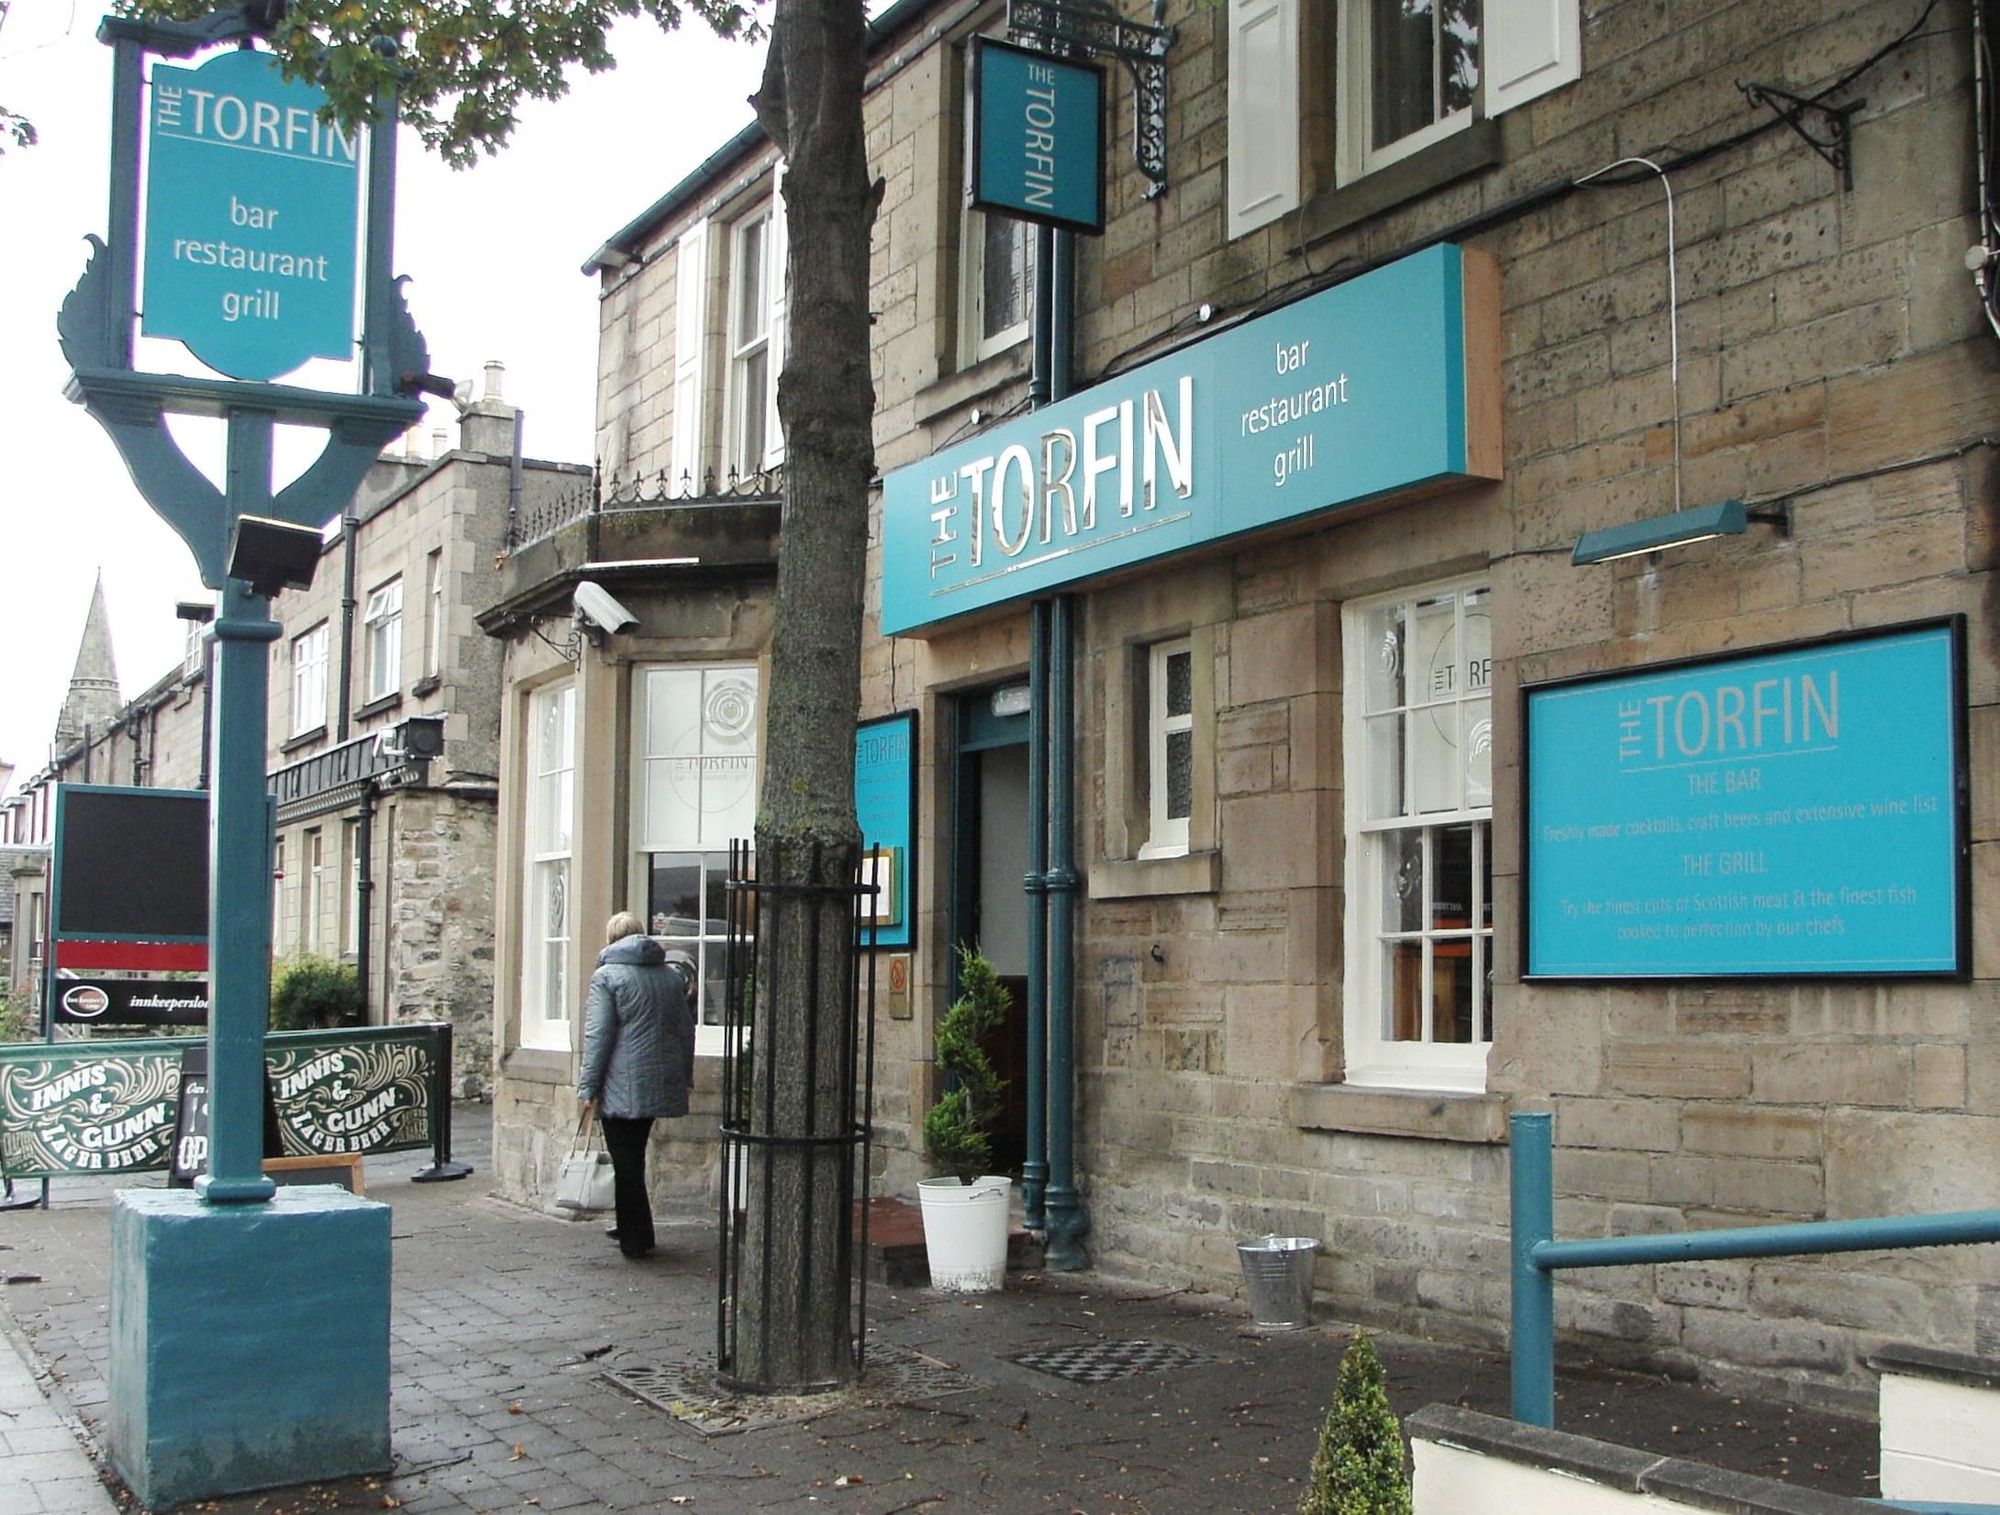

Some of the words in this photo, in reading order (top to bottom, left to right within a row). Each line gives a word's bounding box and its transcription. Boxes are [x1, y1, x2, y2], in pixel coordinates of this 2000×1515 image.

[1027, 63, 1055, 85] THE
[157, 85, 182, 127] THE
[188, 89, 356, 161] TORFIN
[1024, 88, 1055, 208] TORFIN
[230, 196, 279, 230] bar
[173, 238, 328, 282] restaurant
[222, 289, 280, 322] grill
[1276, 340, 1309, 375] bar
[1241, 373, 1348, 437] restaurant
[930, 470, 958, 579] THE
[961, 376, 1192, 568] TORFIN
[1274, 434, 1313, 487] grill
[1445, 658, 1491, 690] TRF
[1619, 700, 1642, 763] THE
[1647, 671, 1839, 759] TORFIN
[1687, 773, 1717, 796] THE
[1725, 768, 1762, 794] BAR
[1764, 807, 1790, 825] and
[1794, 801, 1865, 823] extensive
[1870, 798, 1907, 817] wine
[1913, 794, 1938, 813] list
[1681, 853, 1712, 877] THE
[1719, 850, 1769, 875] GRILL
[1693, 892, 1748, 911] Scottish
[1752, 892, 1788, 909] meat
[1793, 889, 1805, 907] &
[1810, 888, 1834, 906] the
[1839, 885, 1882, 905] finest
[1887, 883, 1917, 904] fish
[1755, 919, 1773, 941] by
[1777, 921, 1801, 937] our
[1805, 915, 1846, 935] chefs
[32, 1065, 106, 1110] INNIS
[280, 1053, 345, 1098] INNIS
[332, 1080, 350, 1101] &
[90, 1093, 112, 1115] &
[327, 1087, 396, 1133] GUNN
[41, 1123, 102, 1169] LAGER
[108, 1139, 158, 1169] BEER
[82, 1103, 166, 1148] GUNN
[291, 1111, 346, 1152] LAGER
[350, 1121, 391, 1151] BEER
